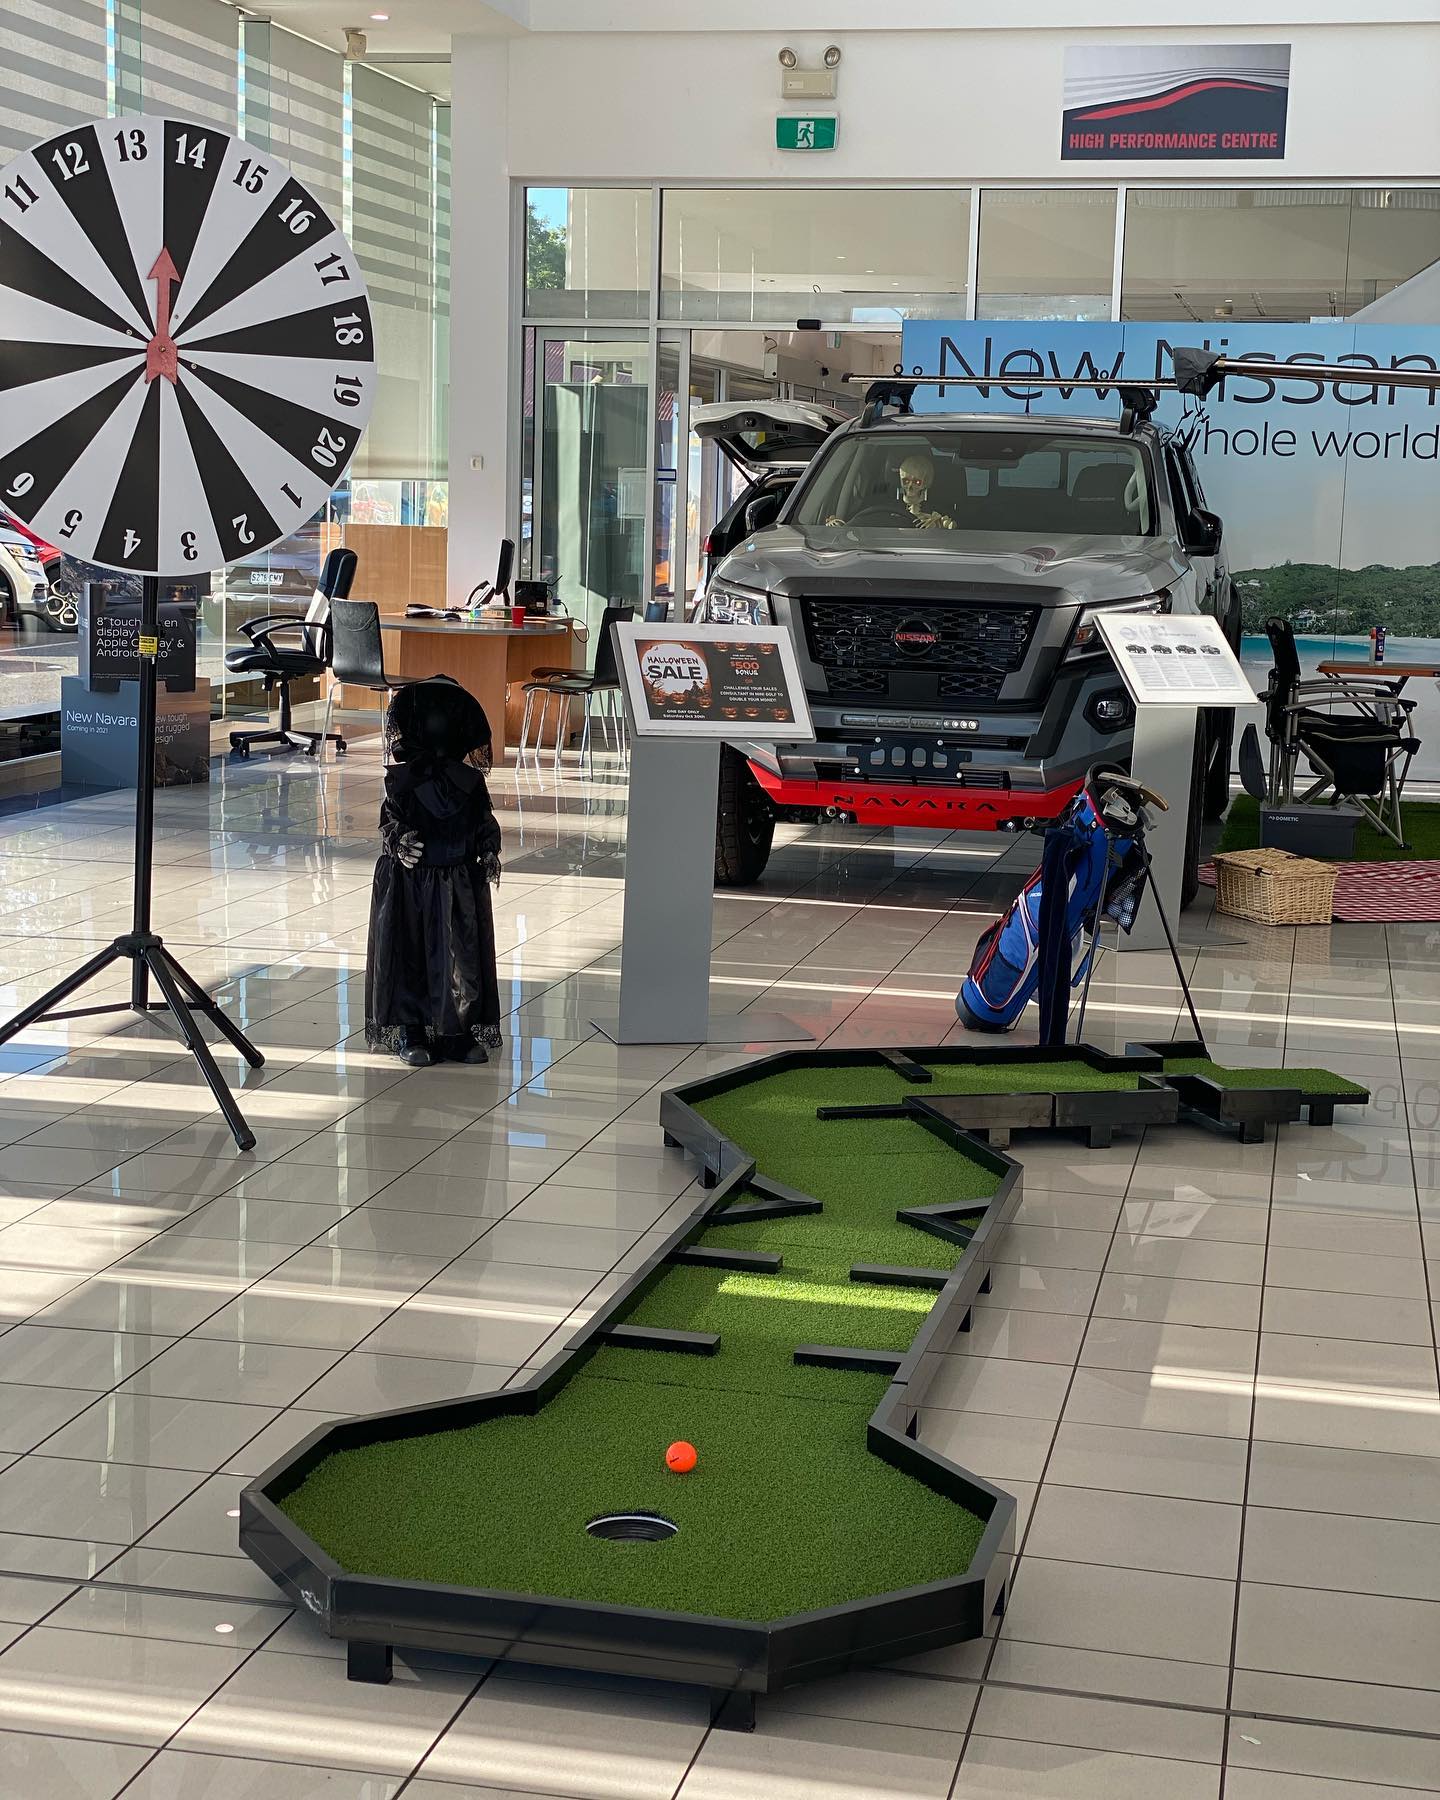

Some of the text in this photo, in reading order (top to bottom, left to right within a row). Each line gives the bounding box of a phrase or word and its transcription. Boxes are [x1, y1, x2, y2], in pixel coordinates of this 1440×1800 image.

[113, 129, 148, 162] 13
[175, 133, 206, 169] 14
[1069, 132, 1278, 149] HIGH PERFORMANCE CENTRE
[52, 142, 91, 181] 12
[232, 158, 270, 195] 15
[4, 174, 40, 213] 11
[277, 197, 317, 235] 16
[314, 251, 350, 287] 17
[333, 311, 365, 346] 18
[938, 336, 1125, 401] New
[333, 374, 364, 407] 19
[310, 427, 347, 469] 20
[1311, 423, 1440, 460] world
[280, 483, 304, 509] 1
[58, 509, 83, 538] 5
[232, 513, 256, 544] 2
[123, 528, 142, 559] 4
[180, 531, 199, 561] 3
[96, 628, 135, 639] display
[96, 638, 128, 650] Apple
[176, 639, 185, 648] &
[895, 633, 936, 643] NISSAN
[647, 655, 699, 666] HALLOWEEN
[648, 665, 703, 680] SALE
[66, 710, 137, 727] New Navara
[67, 724, 89, 734] Coming
[165, 722, 190, 734] rugged
[155, 734, 174, 745] esign
[833, 795, 999, 813] NAVARA
[1275, 815, 1299, 823] DOMETIC
